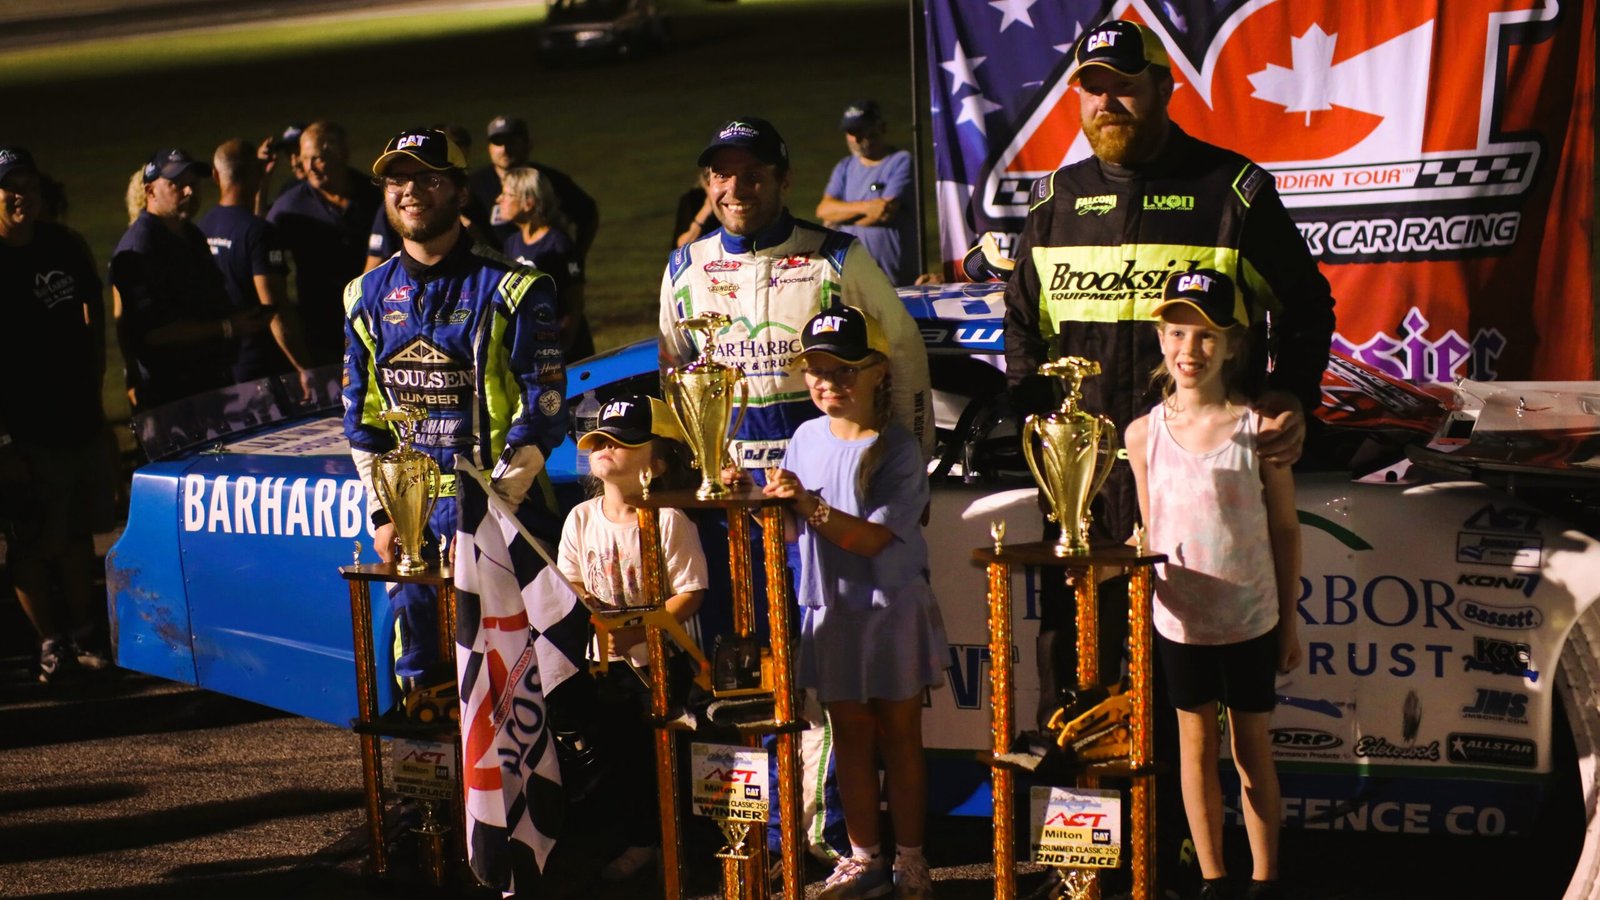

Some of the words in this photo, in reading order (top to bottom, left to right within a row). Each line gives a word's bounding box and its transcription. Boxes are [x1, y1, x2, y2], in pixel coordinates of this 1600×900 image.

[1088, 30, 1120, 52] CAT
[397, 134, 426, 150] CAT
[1344, 168, 1401, 187] TOUR
[1333, 218, 1396, 254] CAR
[1401, 211, 1521, 248] RACING
[779, 276, 814, 284] HOOSIER
[1177, 273, 1212, 294] CAT
[1051, 291, 1139, 301] EQUIPMENT
[812, 315, 845, 336] CAT
[382, 366, 474, 390] POULSEN
[401, 393, 460, 405] LUMBER
[602, 401, 631, 421] CAT
[421, 419, 461, 434] SHAW
[744, 447, 765, 460] DJ
[1457, 574, 1524, 590] KONI
[1308, 642, 1453, 679] RUST
[1462, 689, 1528, 717] JMS
[1272, 733, 1333, 746] DRP
[1466, 739, 1533, 754] ALLSTAR
[704, 768, 757, 783] ACT
[419, 787, 452, 798] PLACE
[704, 783, 737, 794] Milton
[745, 787, 760, 797] CAT
[699, 805, 763, 820] WINNER
[730, 800, 755, 809] CLASSIC
[755, 802, 768, 810] 250
[1045, 812, 1108, 827] ACT
[1280, 796, 1432, 835] FENCE
[1444, 805, 1520, 837] CO.
[1045, 830, 1083, 840] Milton
[1092, 832, 1110, 842] CAT
[1075, 846, 1103, 855] CLASSIC
[1105, 847, 1119, 855] 250
[1035, 853, 1065, 863] 2ND
[1069, 855, 1117, 867] PLACE
